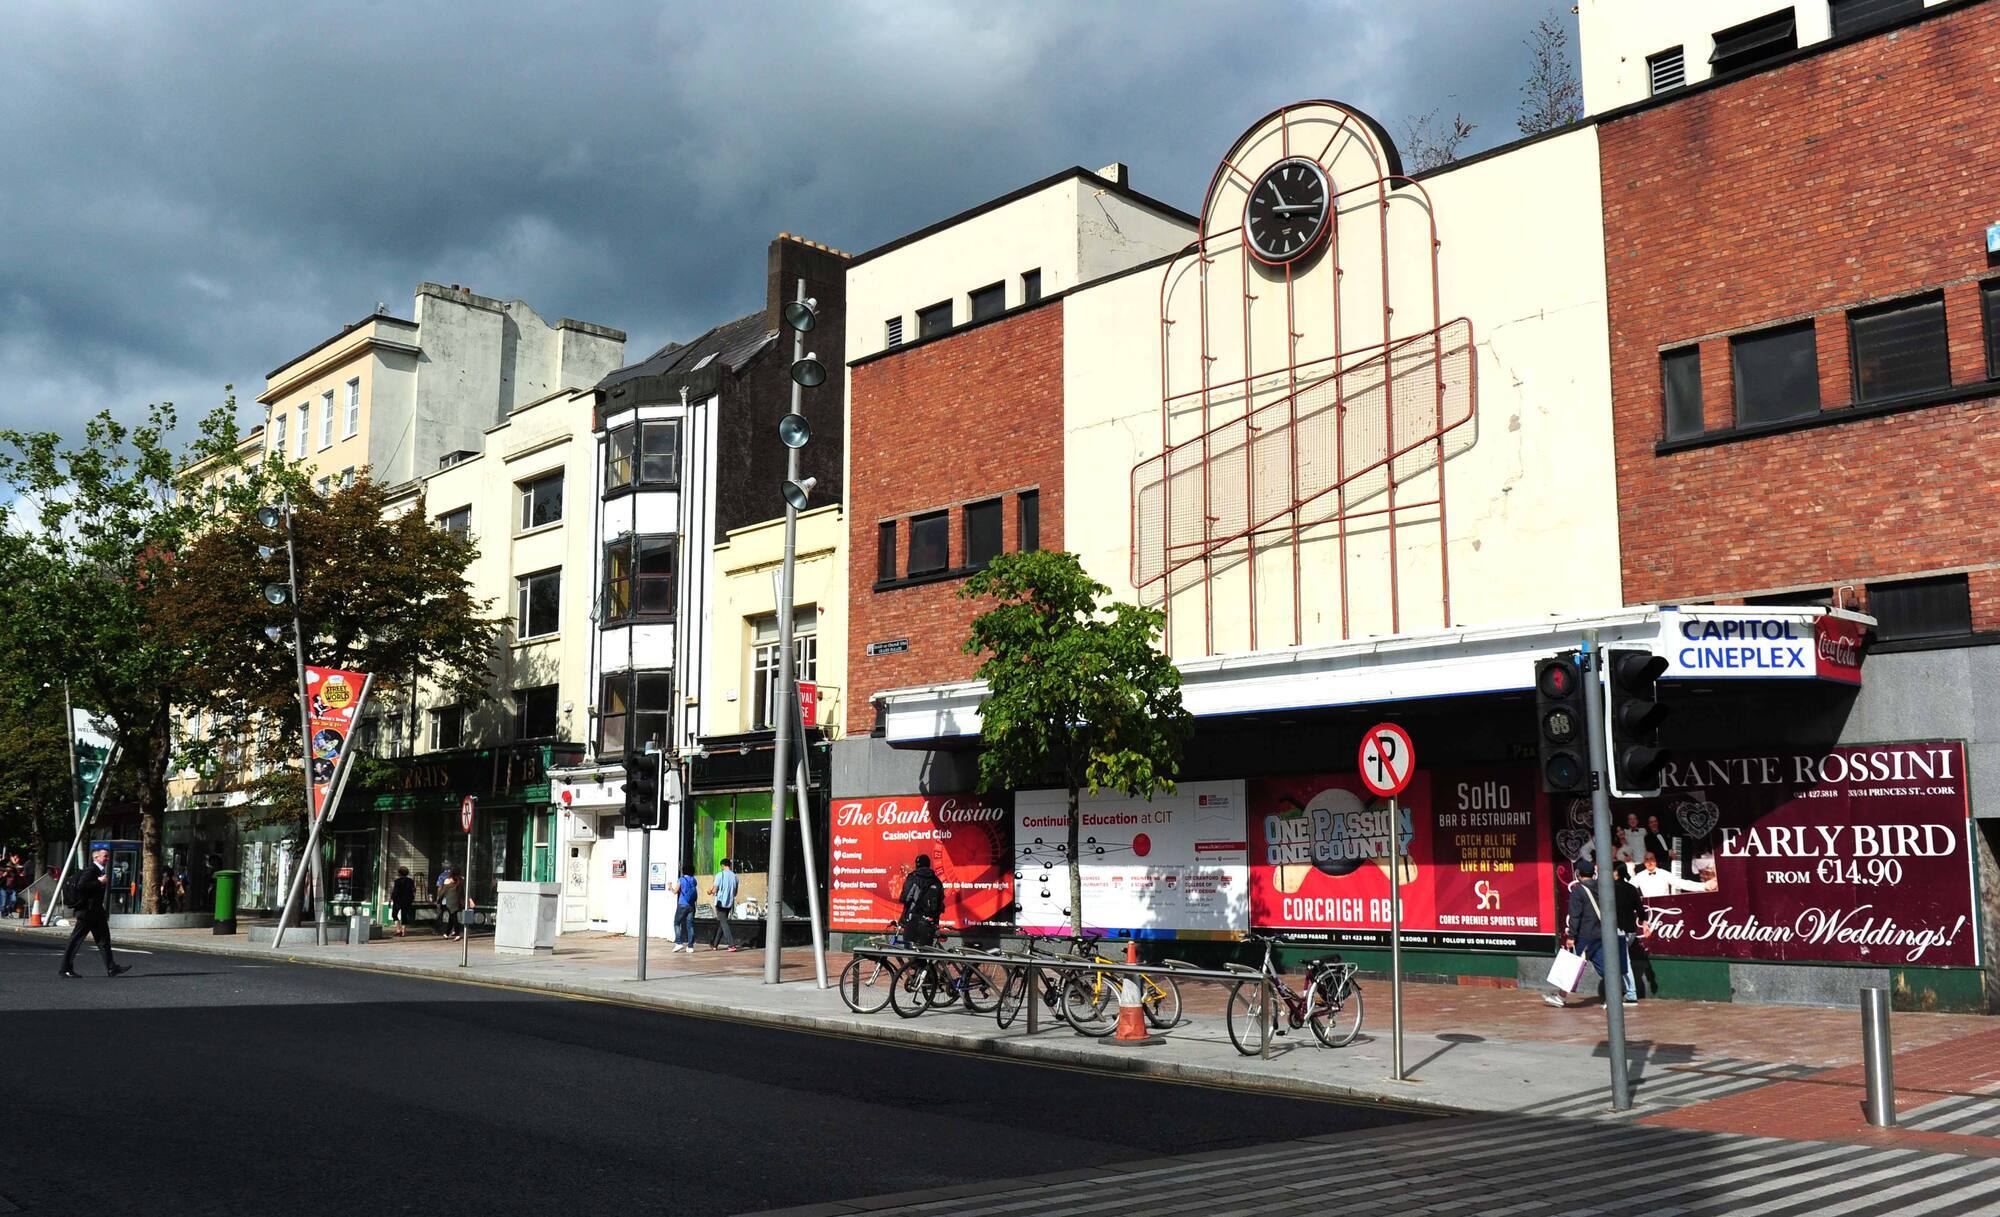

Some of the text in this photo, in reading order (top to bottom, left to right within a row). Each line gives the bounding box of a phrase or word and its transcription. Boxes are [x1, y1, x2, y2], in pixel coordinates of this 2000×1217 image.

[1682, 619, 1798, 641] CAPITOL
[1679, 647, 1806, 669] CINEPLEX
[1793, 749, 1956, 784] ROSSINI
[1868, 788, 1907, 796] PRINCES
[1926, 786, 1955, 795] CORK
[837, 799, 1003, 827] The Bank Casino
[1082, 812, 1138, 825] Education
[1141, 813, 1152, 824] at
[1154, 811, 1173, 823] CIT
[1439, 811, 1531, 827] BAR & RESTAURANT
[932, 829, 952, 839] Club
[1264, 815, 1310, 845] ONE
[1455, 833, 1517, 846] CATCH ALL THE
[1720, 824, 1956, 858] EARLY BIRD
[841, 851, 862, 860] Gaming
[1267, 843, 1312, 865] ONE
[1462, 847, 1511, 859] GAA ACTION
[1460, 860, 1478, 872] LIVE
[1480, 860, 1491, 872] AT
[1766, 859, 1903, 886] FROM €14.90
[840, 881, 859, 889] Special
[974, 882, 992, 890] every
[992, 881, 1009, 890] night
[1283, 897, 1363, 923] CORCAIGH
[1439, 915, 1538, 927] CORKS PREMIER SPORTS VENUE
[1690, 906, 1796, 942] Italian
[1796, 905, 1967, 962] Weddings!
[1485, 938, 1517, 946] FACEBOOK
